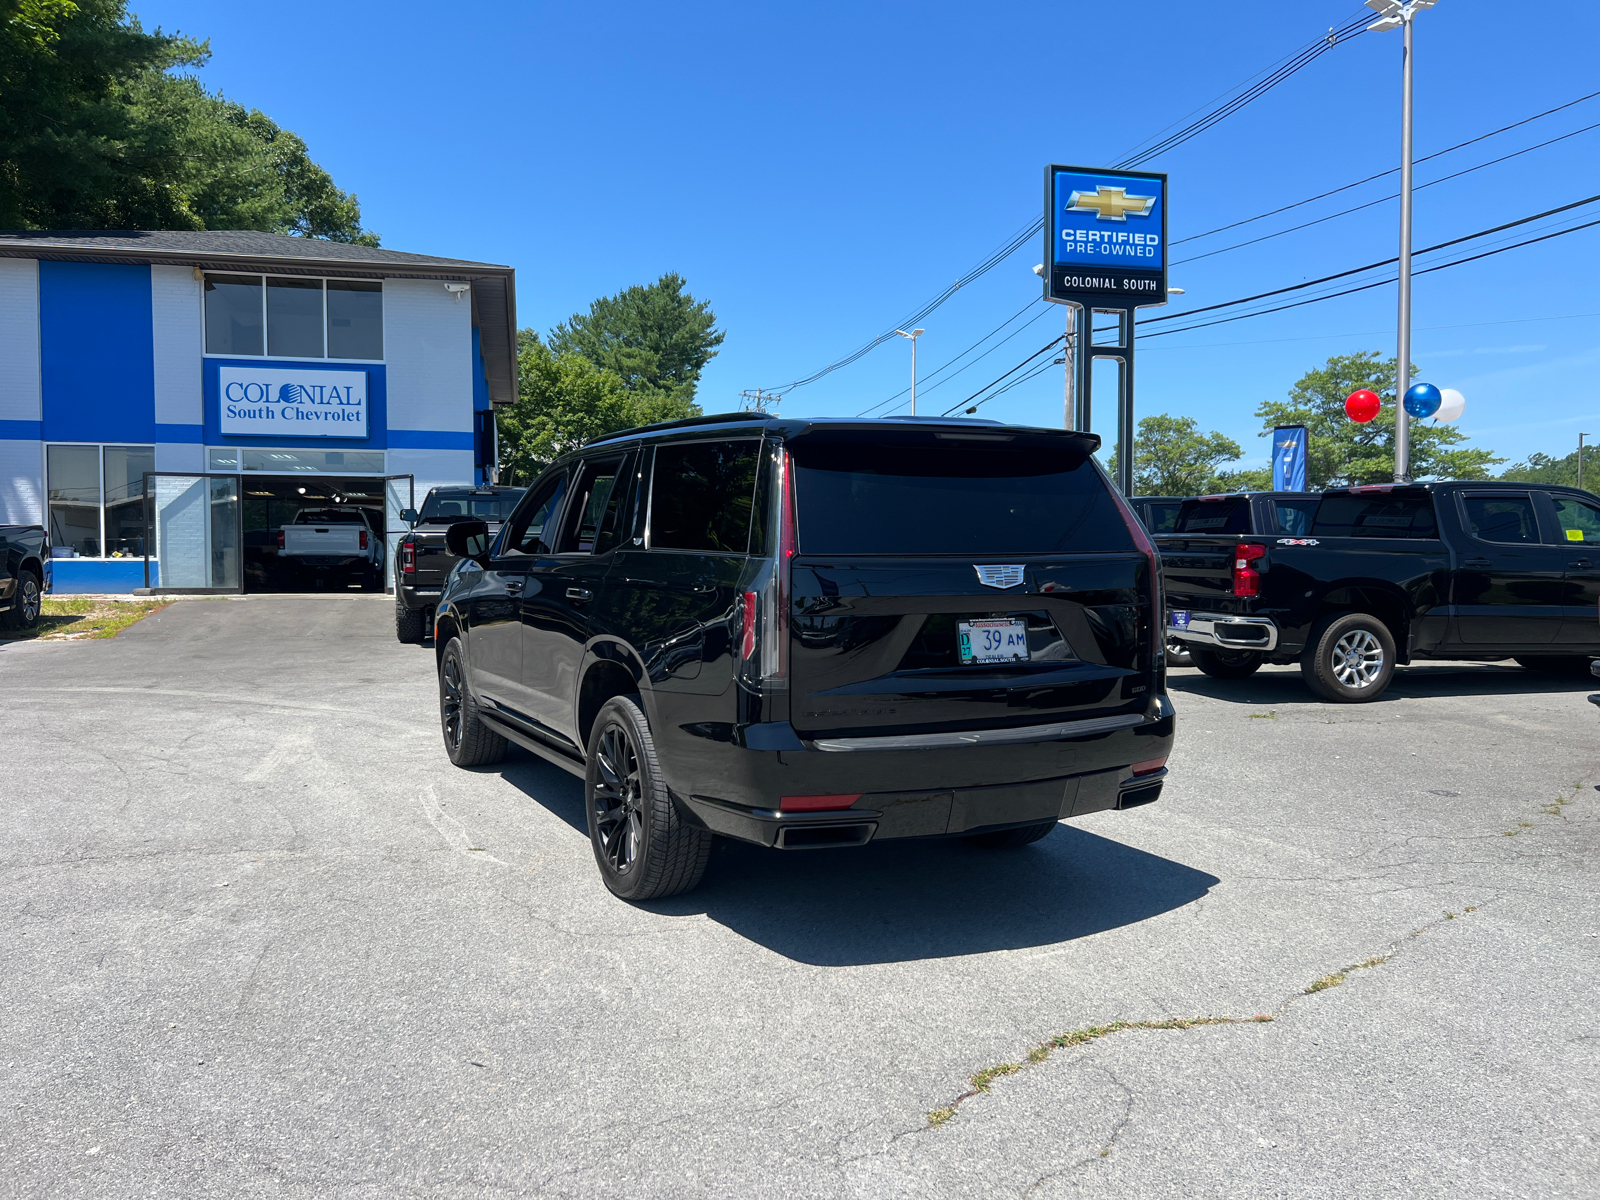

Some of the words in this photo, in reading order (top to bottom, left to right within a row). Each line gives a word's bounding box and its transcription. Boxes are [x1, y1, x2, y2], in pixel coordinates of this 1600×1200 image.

[1061, 229, 1159, 245] CERTIFIED
[1066, 242, 1155, 257] PRE-OWNED
[1064, 276, 1117, 289] COLONIAL
[1123, 278, 1157, 291] SOUTH
[225, 381, 362, 406] COLONIAL
[226, 405, 275, 419] South
[280, 406, 362, 422] Chevrolet
[982, 630, 1002, 651] 39
[1007, 634, 1025, 645] AM
